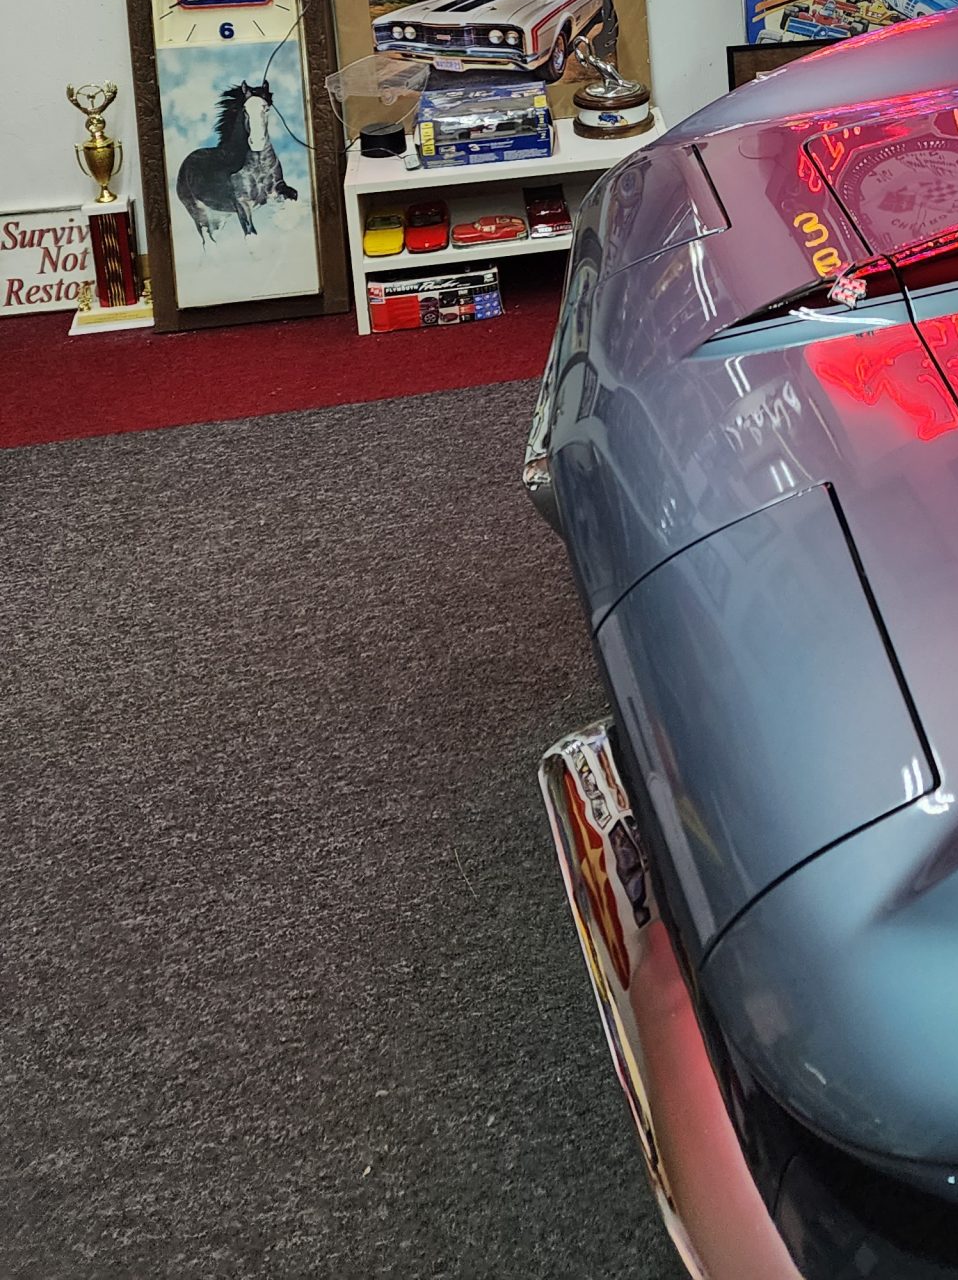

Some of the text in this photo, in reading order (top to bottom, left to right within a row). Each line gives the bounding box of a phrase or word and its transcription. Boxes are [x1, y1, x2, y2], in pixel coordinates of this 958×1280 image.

[219, 22, 235, 39] 6
[36, 245, 90, 274] Not
[386, 285, 419, 294] PLYMOUTH
